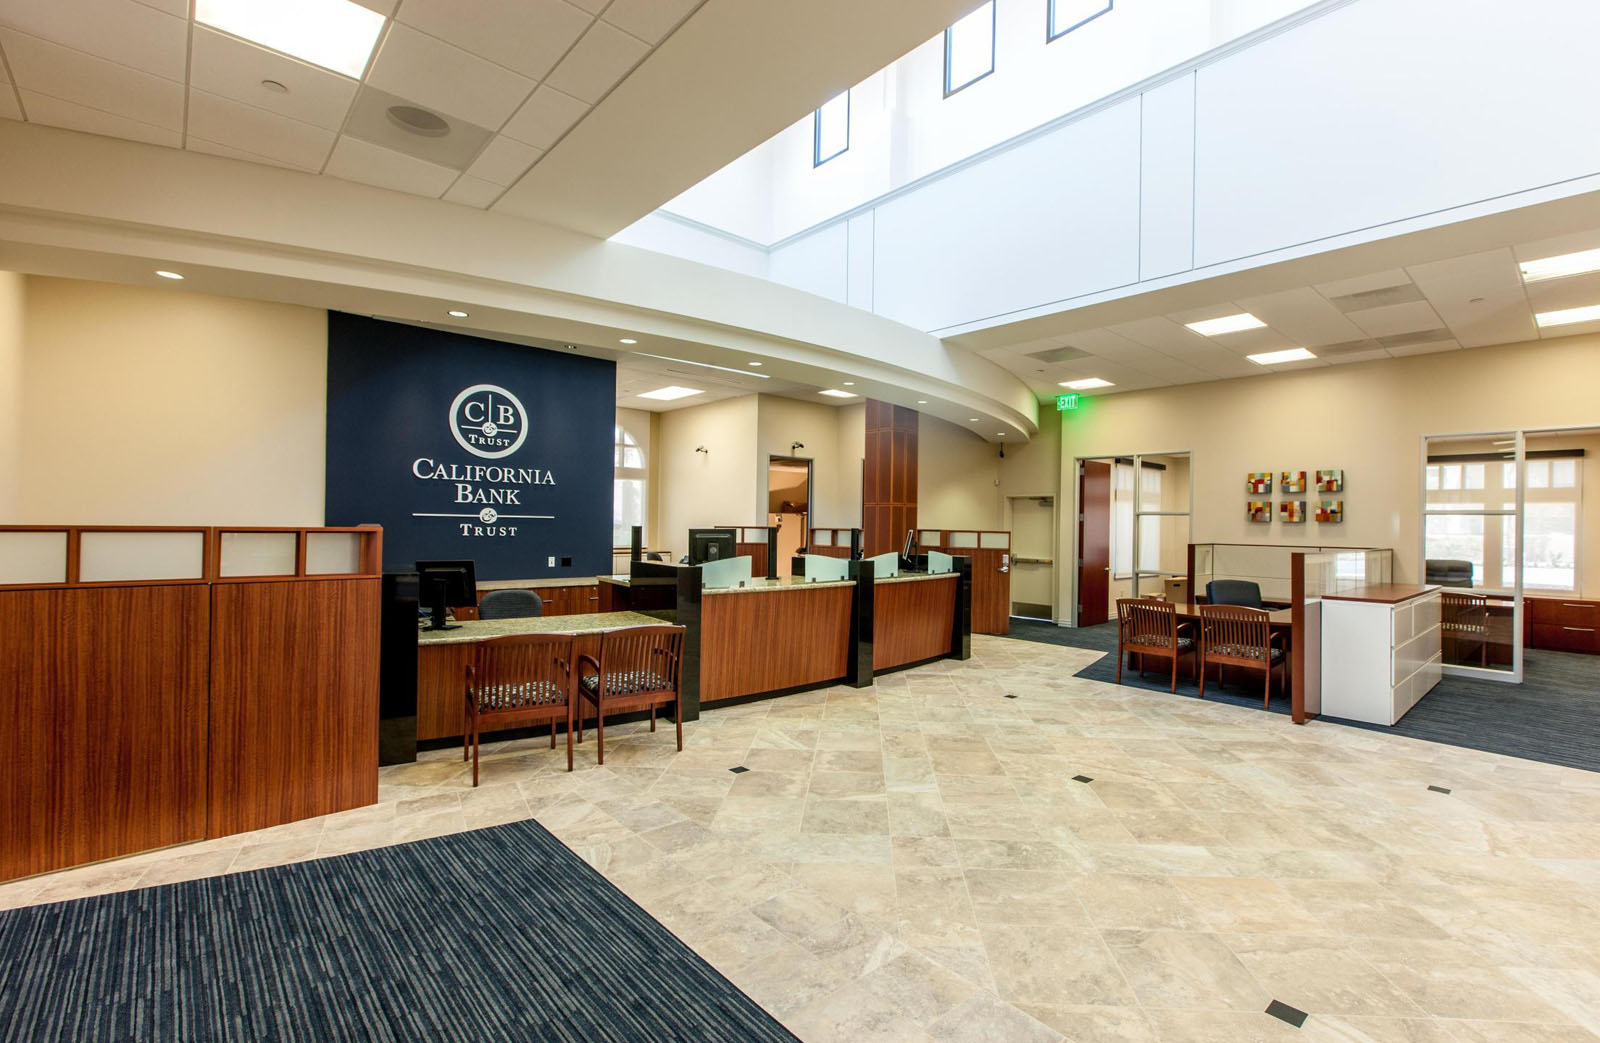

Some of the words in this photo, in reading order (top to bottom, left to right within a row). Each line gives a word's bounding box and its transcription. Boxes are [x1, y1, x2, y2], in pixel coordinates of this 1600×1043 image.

[1059, 396, 1076, 409] EXIT
[464, 401, 485, 423] C
[497, 404, 515, 425] B
[468, 433, 510, 447] TRUST
[412, 457, 556, 485] CALIFORNIA
[454, 483, 521, 505] BANK
[459, 523, 518, 537] TRUST
